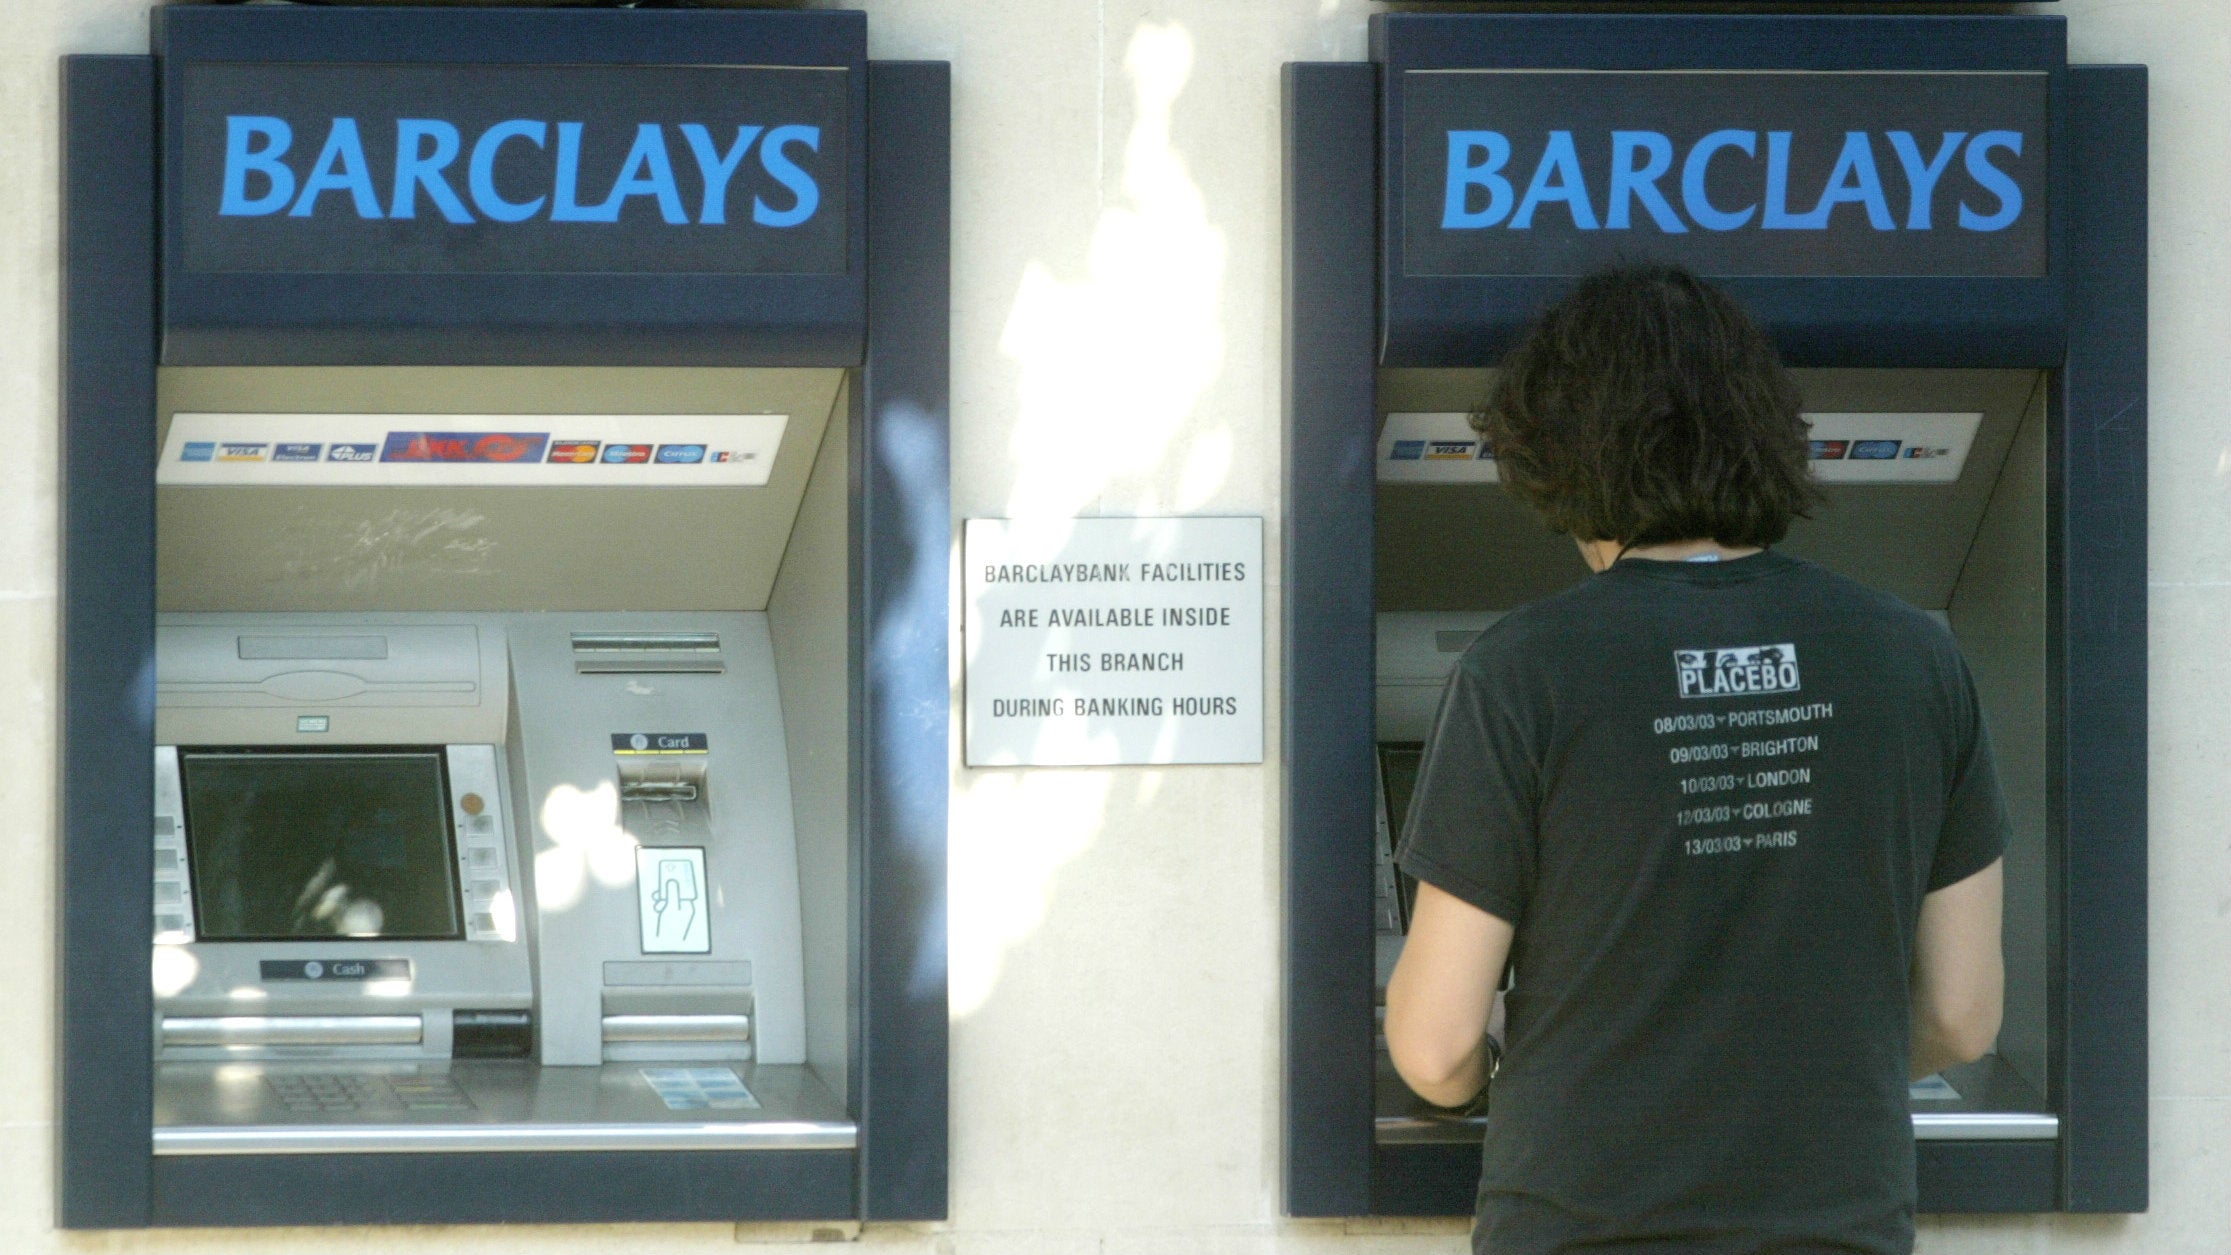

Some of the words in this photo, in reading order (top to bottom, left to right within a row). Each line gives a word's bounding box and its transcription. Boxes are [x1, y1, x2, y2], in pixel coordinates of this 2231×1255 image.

[219, 115, 821, 228] BARCLAYS
[1441, 129, 2024, 233] BARCLAYS
[226, 447, 259, 456] VISA
[342, 452, 372, 461] PLUS
[1435, 446, 1467, 454] VISA
[985, 563, 1131, 583] BARCLAYBANK
[1141, 562, 1246, 582] FACILITIES
[1000, 609, 1039, 627] ARE
[1048, 608, 1154, 627] AVAILABLE
[1162, 607, 1231, 626] INSIDE
[1047, 653, 1091, 672] THIS
[1101, 652, 1184, 671] BRANCH
[1680, 662, 1798, 694] PLACEBO
[993, 698, 1065, 717] DURING
[1074, 697, 1163, 717] BANKING
[1172, 696, 1238, 716] HOURS
[1653, 714, 1716, 735] 08/03/03
[1728, 702, 1833, 728] PORTSMOUTH
[658, 736, 690, 748] Card
[1669, 744, 1729, 764] 09/03/03
[1741, 735, 1819, 758] BRIGHTON
[1747, 768, 1811, 789] LONDON
[1743, 798, 1813, 820] COLOGNE
[1755, 830, 1798, 849] PARIS
[332, 963, 365, 976] Cash
